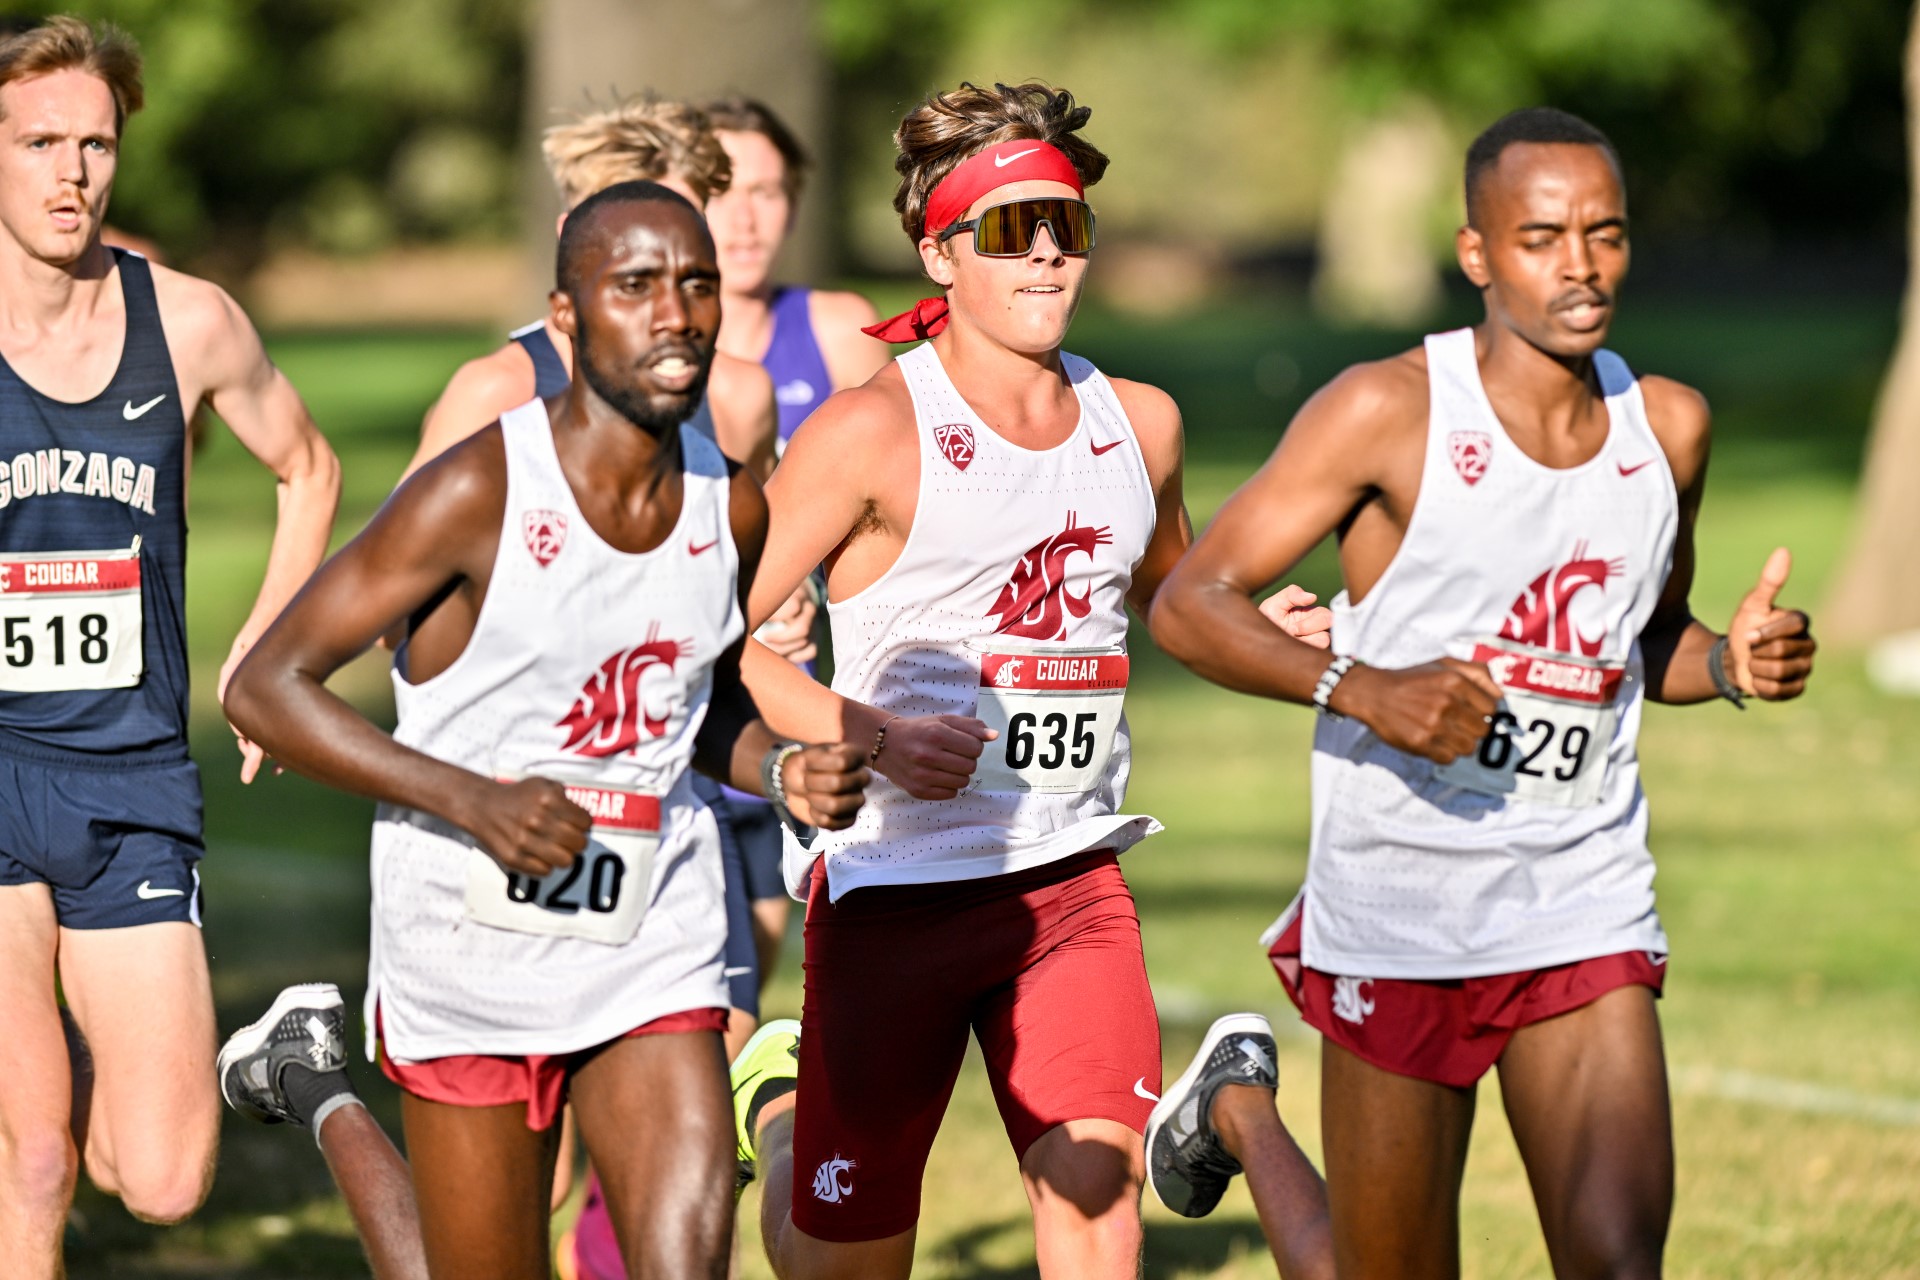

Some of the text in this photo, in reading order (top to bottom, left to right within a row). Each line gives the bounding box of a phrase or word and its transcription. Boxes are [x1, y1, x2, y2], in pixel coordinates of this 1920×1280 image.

[934, 425, 974, 453] PAC
[948, 444, 971, 462] 12
[1457, 458, 1486, 477] 12
[531, 540, 558, 559] 12
[24, 561, 99, 586] COUGAR
[4, 613, 109, 668] 518
[1036, 659, 1099, 681] COUGAR
[1526, 659, 1604, 695] COUGAR
[1087, 679, 1119, 688] CLASSIC
[1005, 712, 1098, 770] 635
[1478, 711, 1590, 781] 629
